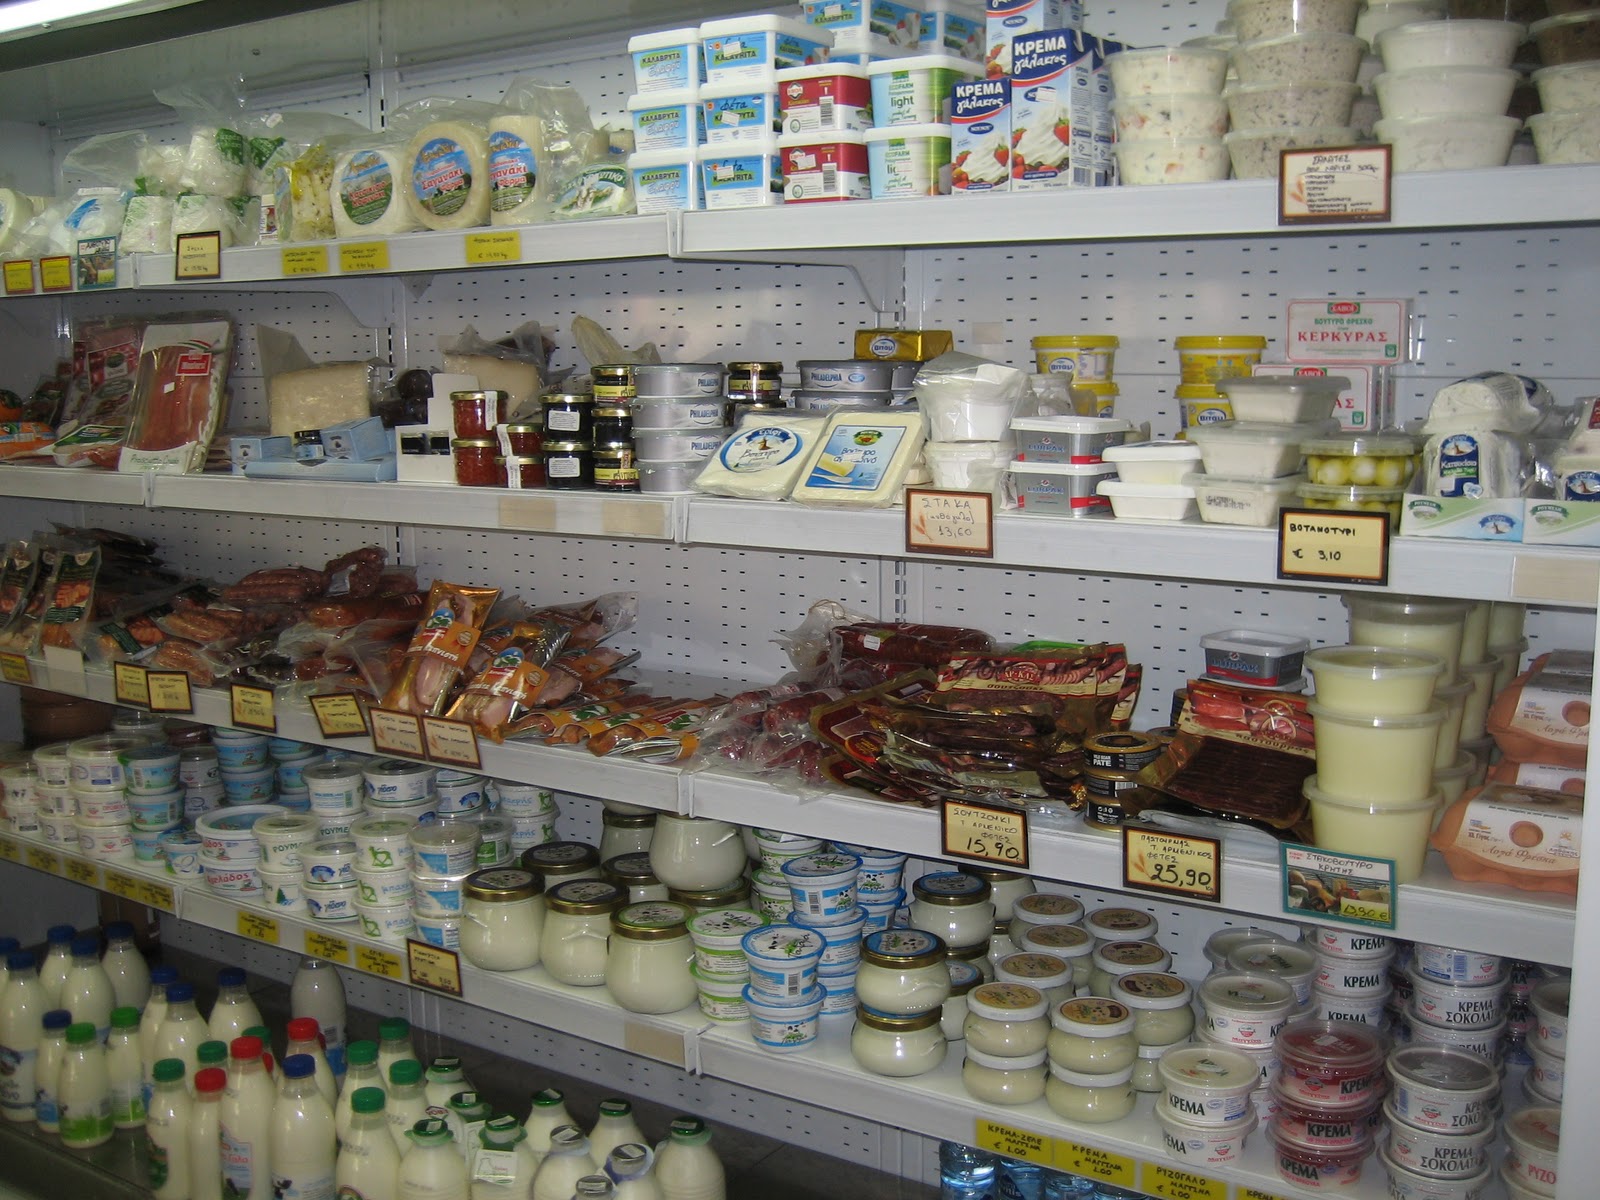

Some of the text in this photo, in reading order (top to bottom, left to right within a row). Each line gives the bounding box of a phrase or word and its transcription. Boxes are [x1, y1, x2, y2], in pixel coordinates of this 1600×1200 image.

[1014, 36, 1067, 56] ΚΡΕΜΑ
[955, 82, 1003, 98] ΚΡΕΜΑ
[890, 95, 914, 108] light
[1297, 331, 1388, 342] ΚΕΡΚΥΡΑΣ
[811, 373, 842, 381] PHILADELPHIA
[1289, 523, 1356, 536] ΒΟΤΑΝΟΤΥΡΙ
[1318, 549, 1342, 562] 3,10
[1093, 759, 1112, 767] PATE
[320, 826, 349, 836] ΡΟΥΜΕ
[966, 836, 1020, 860] 15,90
[1306, 853, 1373, 870] ΣΤΑΚΟΒΟΥΤΥΡΟ
[1150, 863, 1212, 887] 25,90
[1318, 864, 1354, 876] ΚΡΗΤΗΣ
[1351, 937, 1386, 950] ΚΡΕΜΑ
[1344, 974, 1380, 988] ΚΡΕΜΑ
[1458, 999, 1493, 1012] ΚΡΕΜΑ
[1445, 1010, 1497, 1024] ΣΟΚΟΛΑΤ
[1169, 1092, 1205, 1116] ΚΡΕΜΑ
[1307, 1121, 1352, 1138] ΚΡΕΜΑ
[1071, 1144, 1108, 1160] ΚΡΕΜΑ
[1434, 1146, 1473, 1160] ΚΡΕΜΑ
[1280, 1157, 1319, 1180] ΚΡΕΜΑ
[1156, 1166, 1206, 1186] ΡΥΖΟΓΑΛΟ
